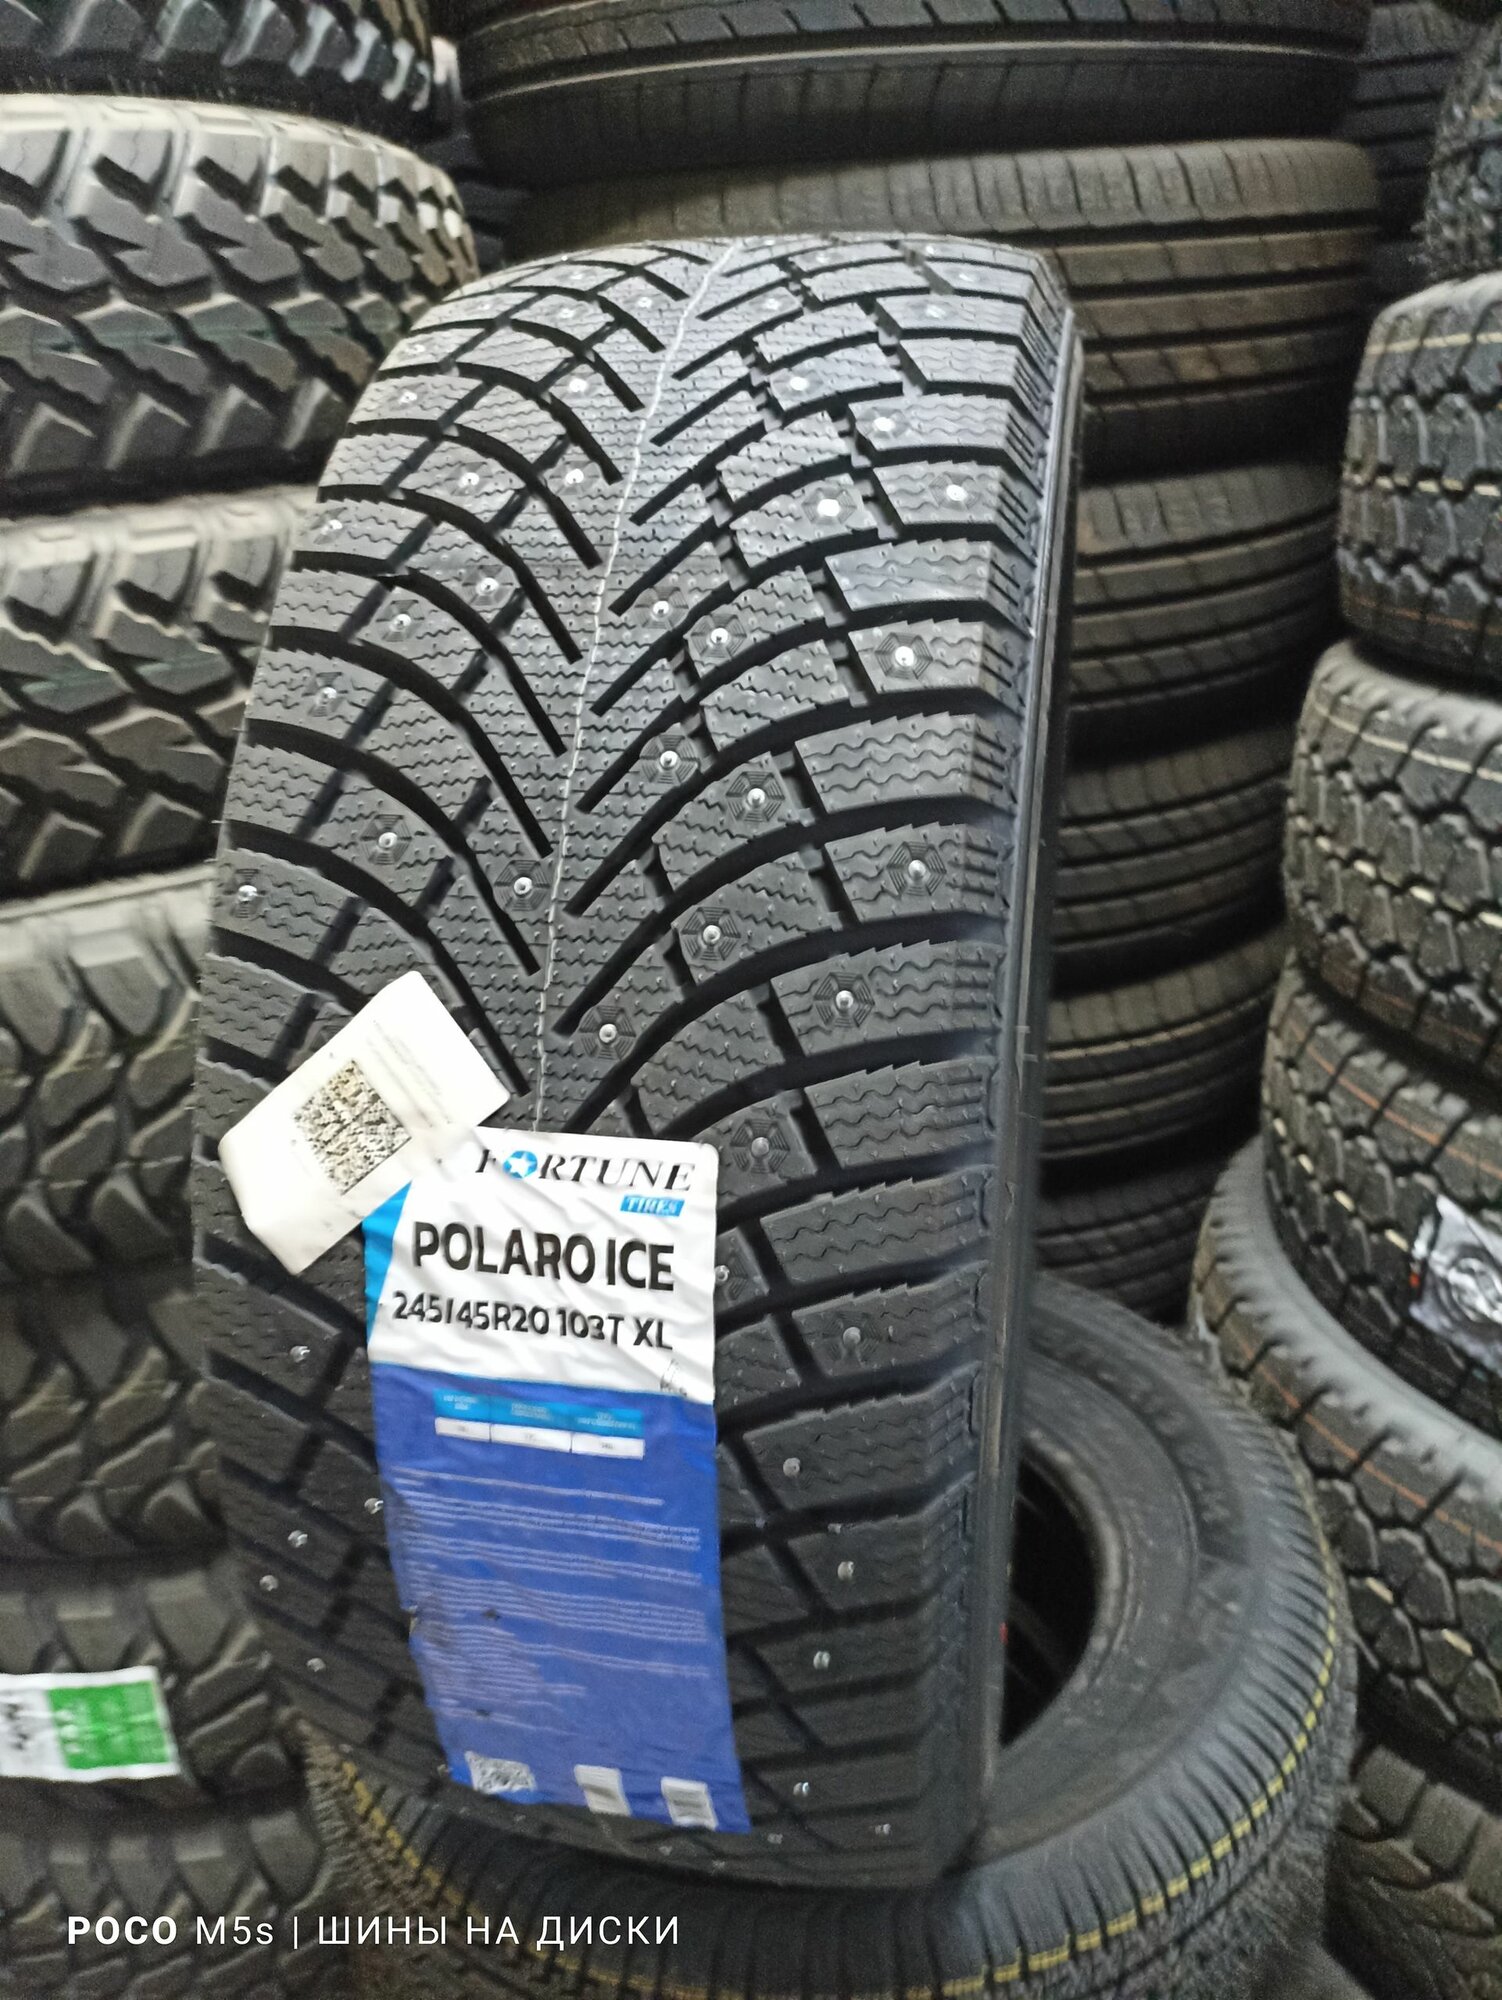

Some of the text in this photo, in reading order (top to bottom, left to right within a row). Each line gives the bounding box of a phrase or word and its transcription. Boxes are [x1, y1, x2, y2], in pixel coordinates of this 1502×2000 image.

[412, 1221, 675, 1292] POLARO ICE
[556, 1307, 625, 1345] 103T
[632, 1317, 674, 1351] XL
